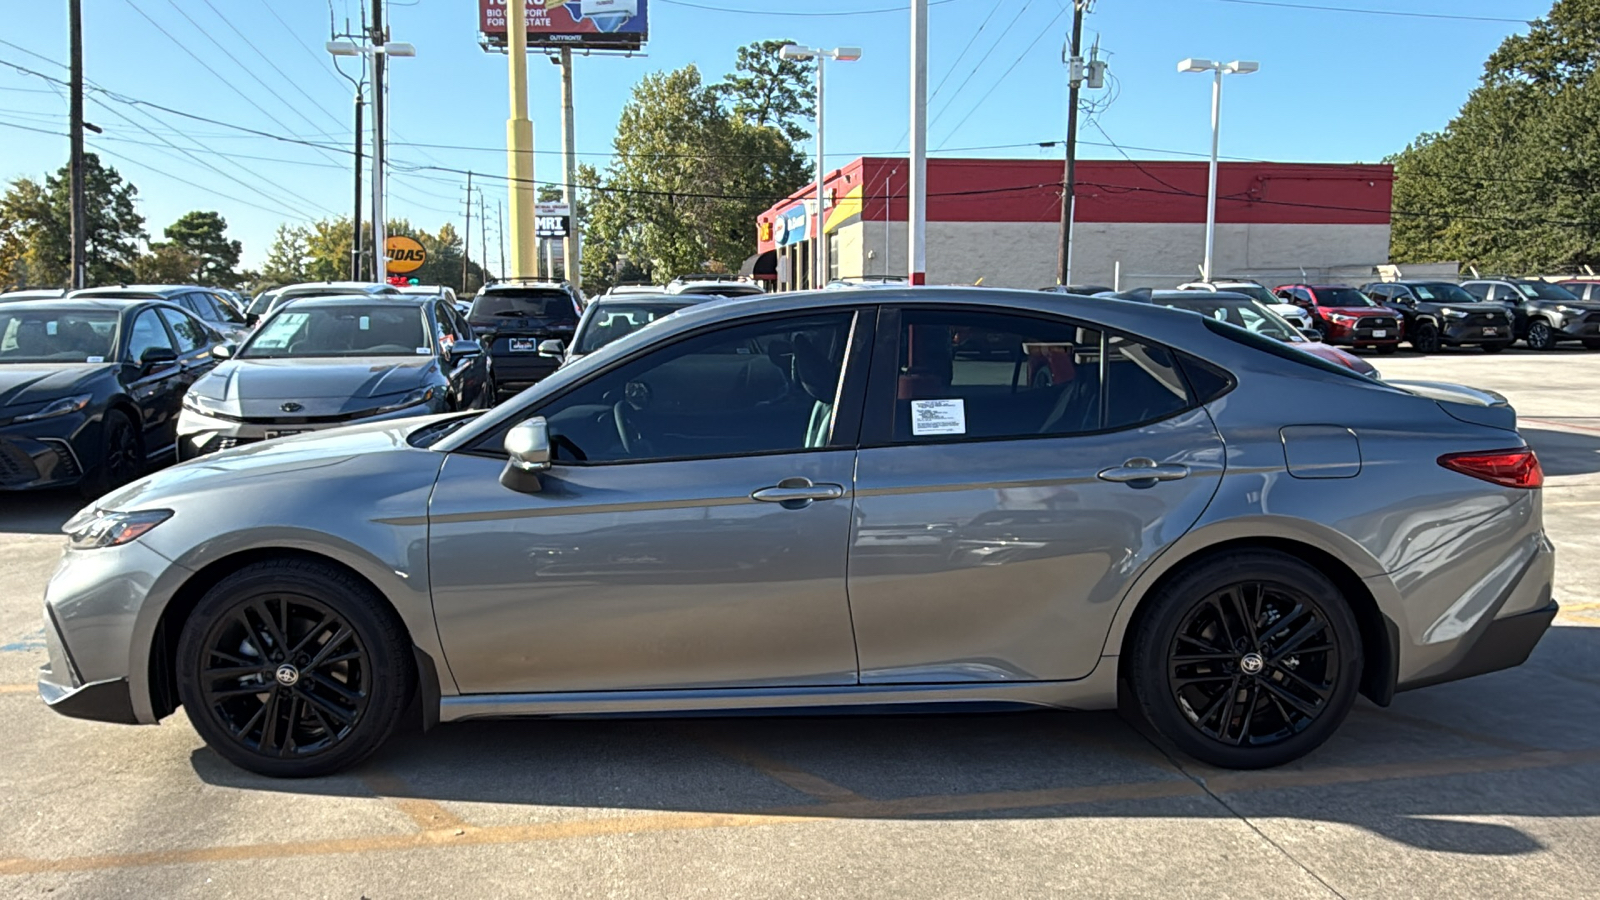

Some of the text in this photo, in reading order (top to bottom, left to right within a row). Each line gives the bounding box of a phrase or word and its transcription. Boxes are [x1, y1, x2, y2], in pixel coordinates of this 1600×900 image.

[486, 9, 502, 17] BIG
[486, 18, 505, 26] FOR
[535, 216, 563, 230] MRI
